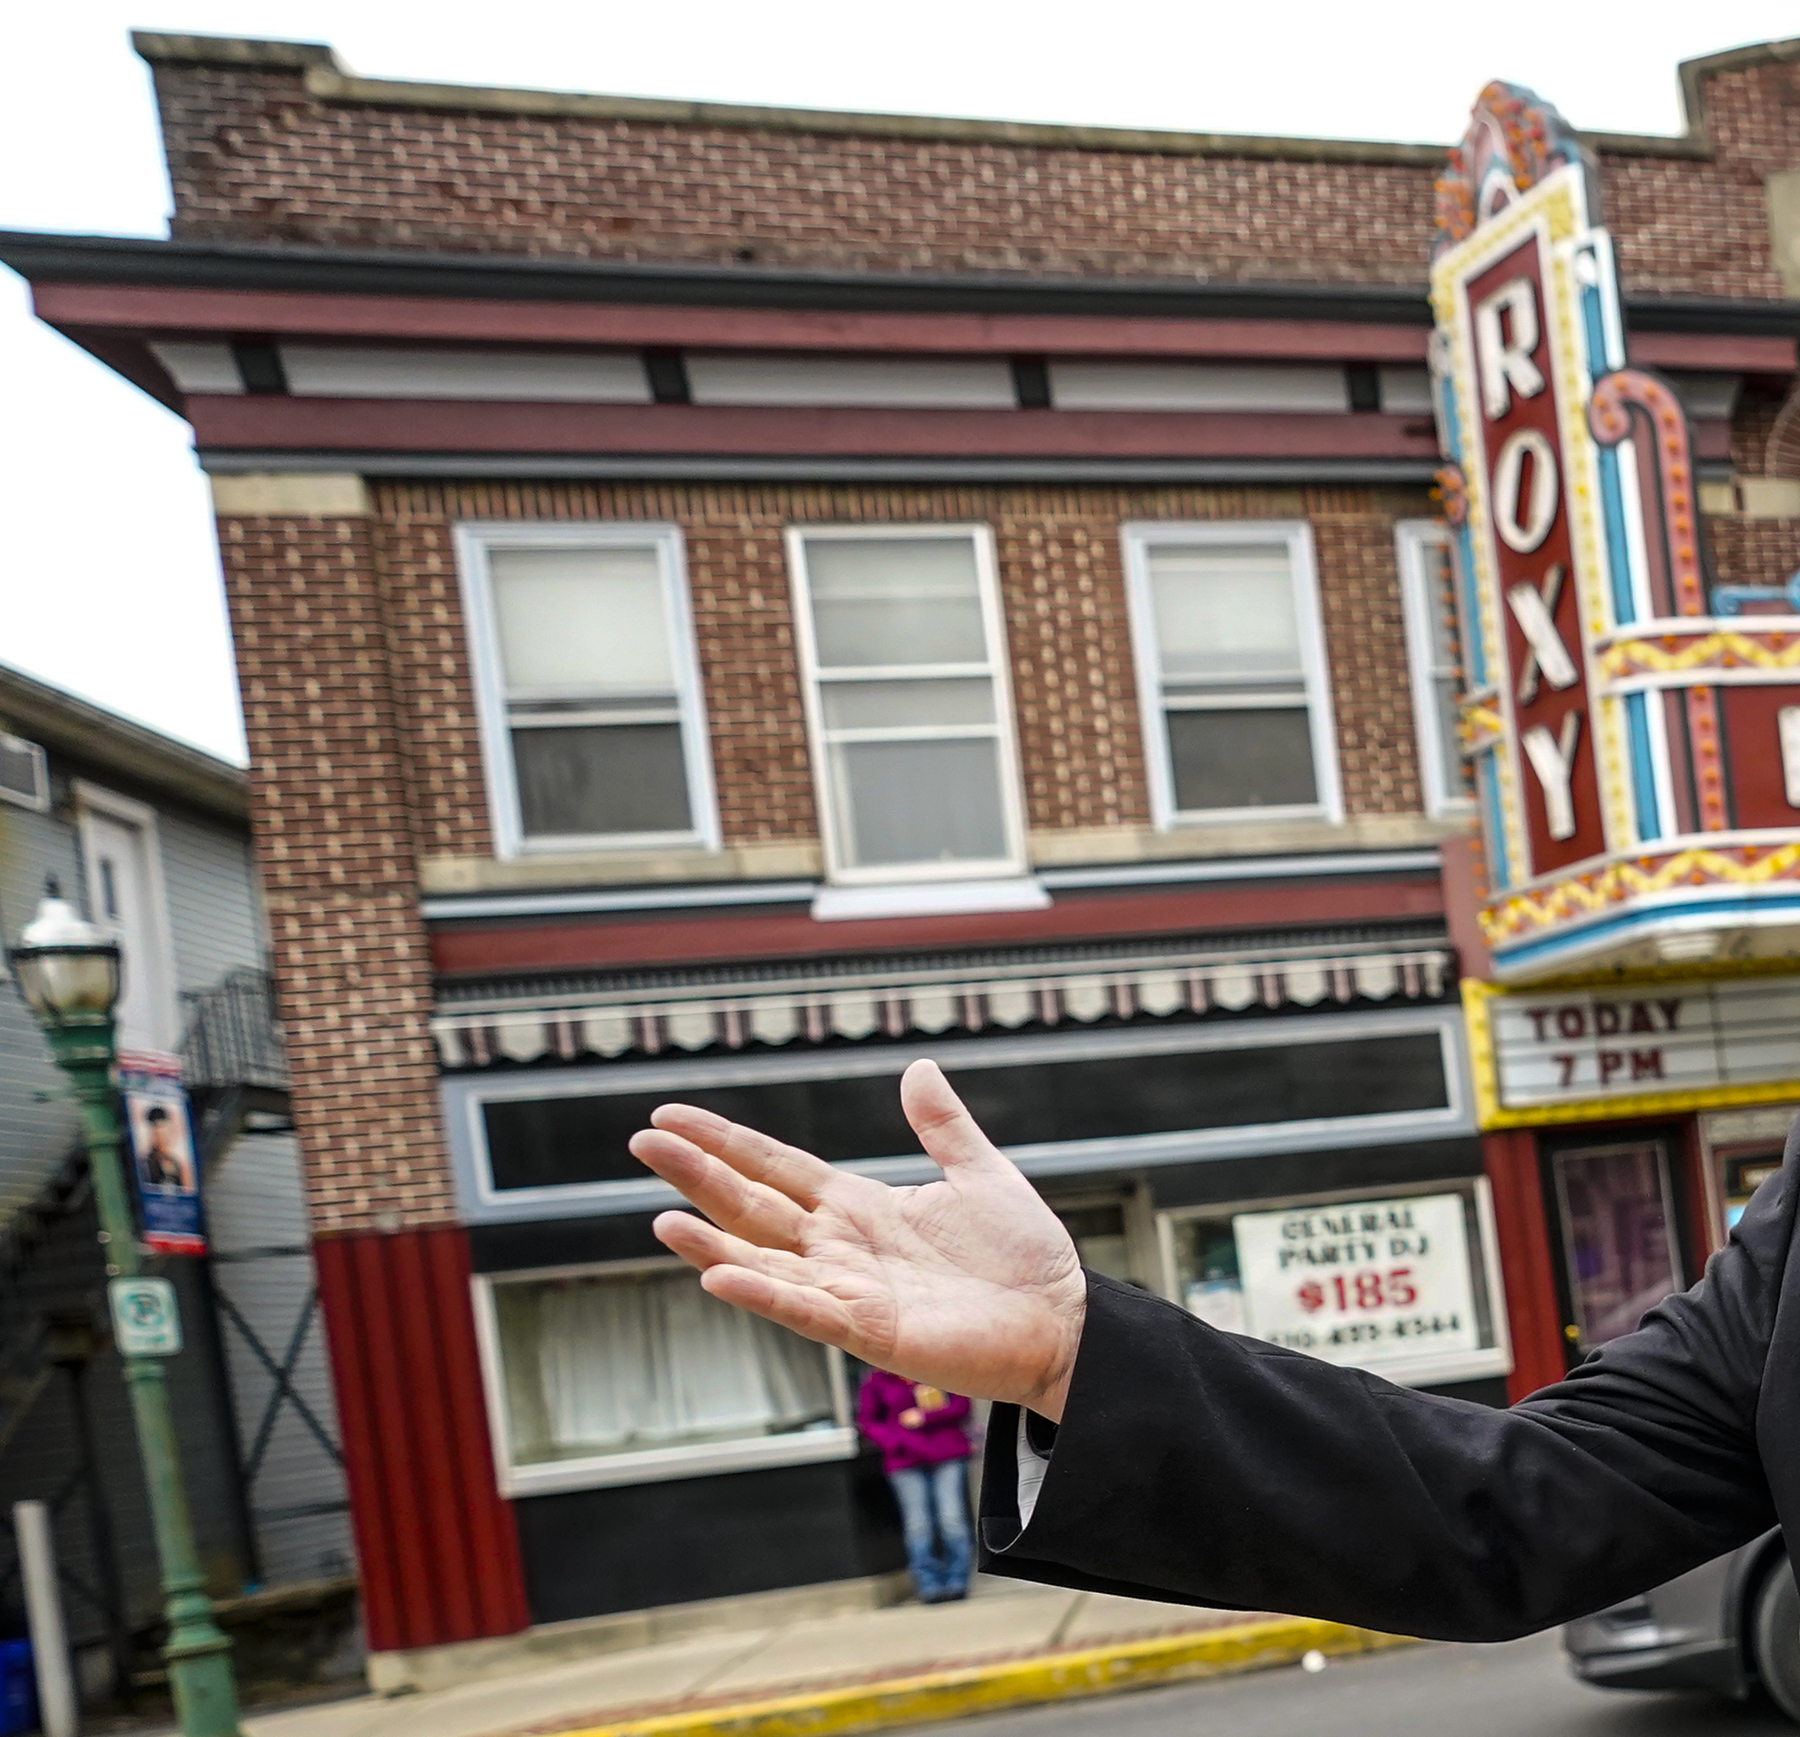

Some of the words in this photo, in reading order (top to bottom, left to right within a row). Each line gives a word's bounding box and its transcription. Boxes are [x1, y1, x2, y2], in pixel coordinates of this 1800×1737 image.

[1475, 275, 1582, 842] ROXY
[1523, 998, 1683, 1042] TODAY
[1552, 1053, 1577, 1088] 7
[1599, 1046, 1666, 1086] PM
[1281, 1209, 1415, 1240] GENERAL
[1278, 1240, 1375, 1269] PARTY
[1389, 1234, 1429, 1257] DJ
[1297, 1268, 1417, 1314] $185
